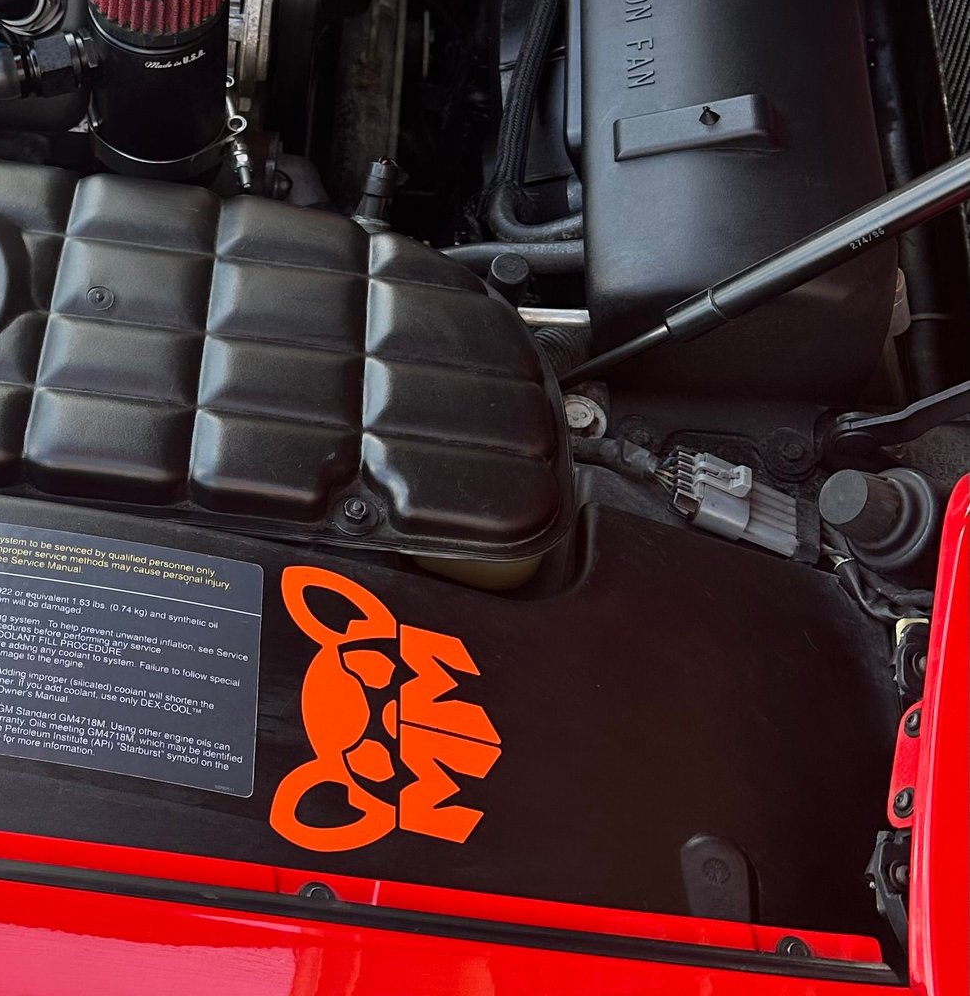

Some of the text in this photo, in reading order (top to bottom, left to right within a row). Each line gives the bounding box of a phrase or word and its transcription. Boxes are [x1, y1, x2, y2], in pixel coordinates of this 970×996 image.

[144, 61, 173, 69] Made
[626, 37, 656, 89] FAN
[850, 227, 885, 250] 274/96
[10, 556, 46, 569] Service
[47, 561, 84, 574] Manual.
[29, 539, 39, 548] to
[40, 541, 52, 550] be
[54, 542, 93, 556] serviced
[94, 548, 107, 559] by
[108, 550, 147, 566] qualified
[149, 557, 194, 574] personnel
[34, 549, 68, 562] service
[69, 554, 109, 569] methods
[111, 563, 131, 574] may
[133, 566, 161, 577] cause
[163, 570, 203, 586] personal
[12, 597, 26, 607] will
[27, 599, 39, 609] be
[14, 590, 24, 598] or
[25, 590, 69, 606] equivalent
[149, 610, 166, 621] and
[168, 613, 206, 629] synthetic
[208, 620, 219, 630] oil
[38, 636, 58, 647] FILL
[60, 639, 123, 657] PROCEDURE
[15, 706, 57, 721] Standard
[110, 721, 137, 736] Using
[138, 726, 161, 739] other
[163, 731, 194, 747] engine
[196, 737, 212, 749] oils
[214, 742, 230, 752] can
[2, 733, 16, 744] for
[17, 737, 41, 748] more
[43, 740, 96, 757] information.
